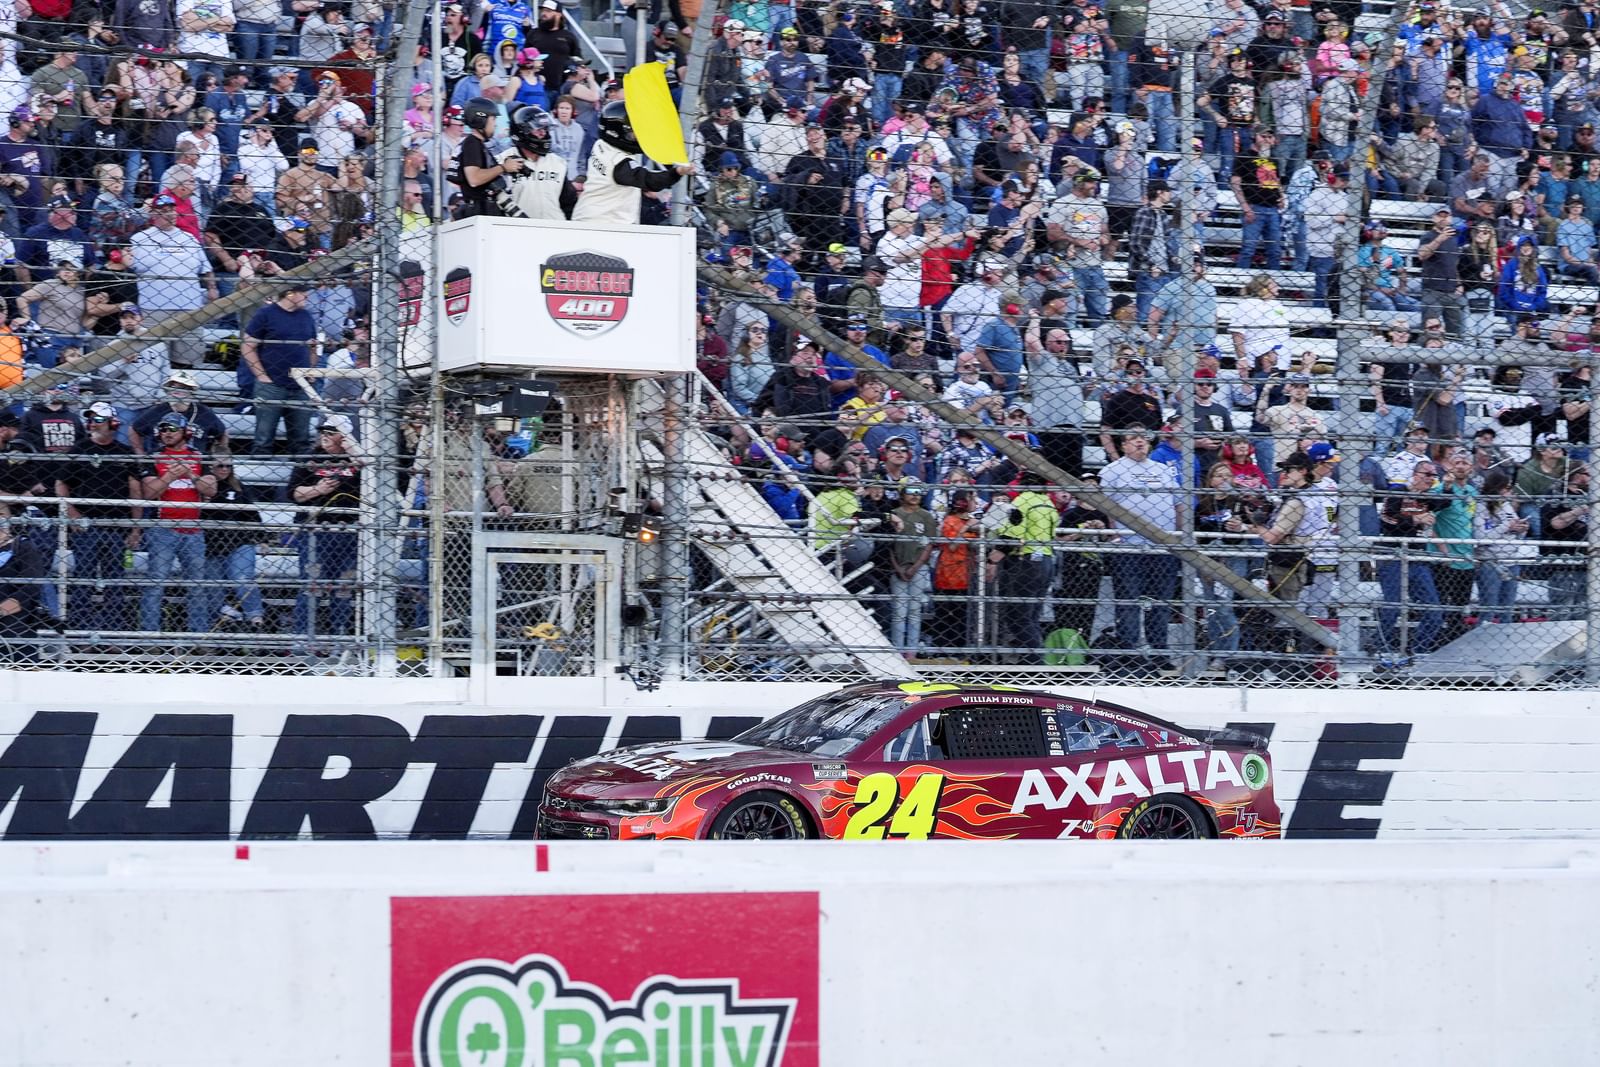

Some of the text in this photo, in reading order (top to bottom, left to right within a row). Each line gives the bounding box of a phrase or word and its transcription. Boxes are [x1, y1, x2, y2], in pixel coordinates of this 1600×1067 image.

[554, 270, 632, 293] COOK OUT
[558, 299, 615, 317] 400
[961, 696, 999, 704] WILLIAM
[727, 772, 792, 789] GOODYEAR
[1011, 750, 1243, 814] AXALTA
[843, 772, 945, 840] 24
[1056, 819, 1082, 839] Z
[1083, 821, 1094, 833] hp
[1235, 806, 1259, 834] LU
[438, 980, 766, 1067] O'Reilly
